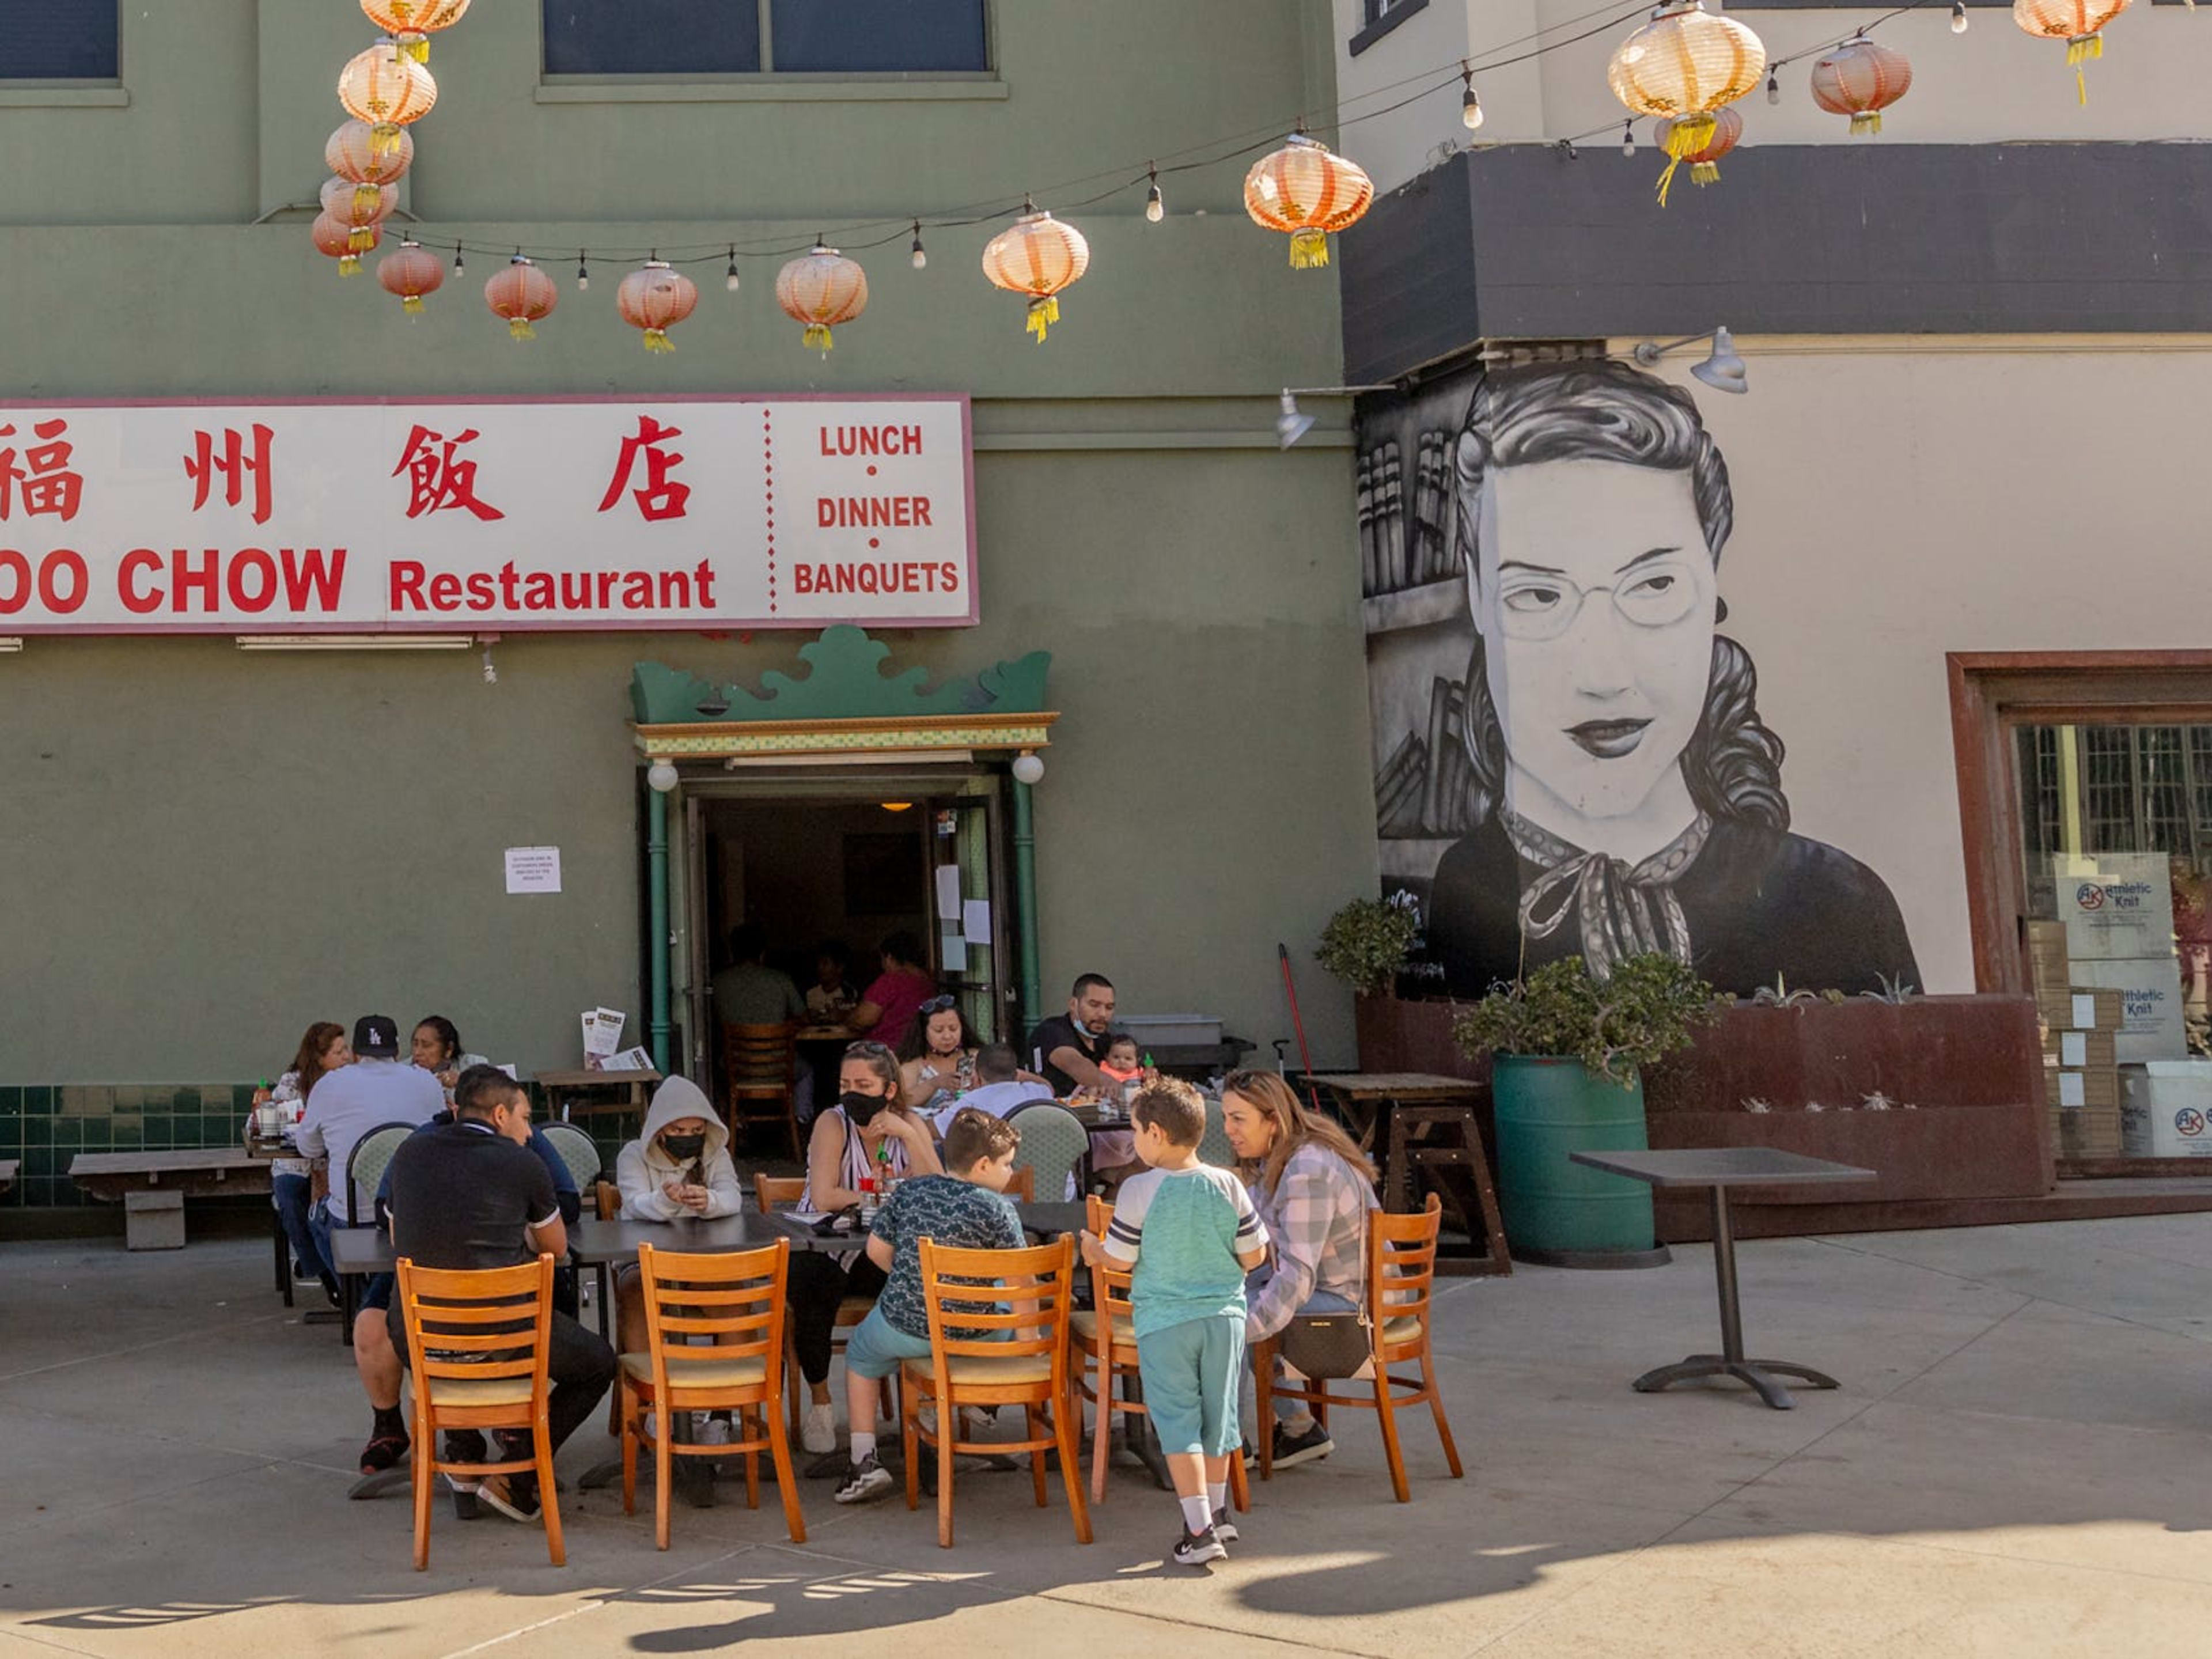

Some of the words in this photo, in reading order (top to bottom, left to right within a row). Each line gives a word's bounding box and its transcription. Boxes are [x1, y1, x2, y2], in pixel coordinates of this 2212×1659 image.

[821, 426, 922, 455] LUNCH
[0, 416, 691, 524] 福州飯店
[817, 497, 931, 527] DINNER
[118, 548, 347, 613] CHOW
[389, 559, 717, 612] Restaurant
[795, 562, 959, 594] BANQUETS
[2115, 896, 2140, 910] Knit
[2122, 988, 2165, 1002] thletic
[2127, 1002, 2153, 1017] Knit
